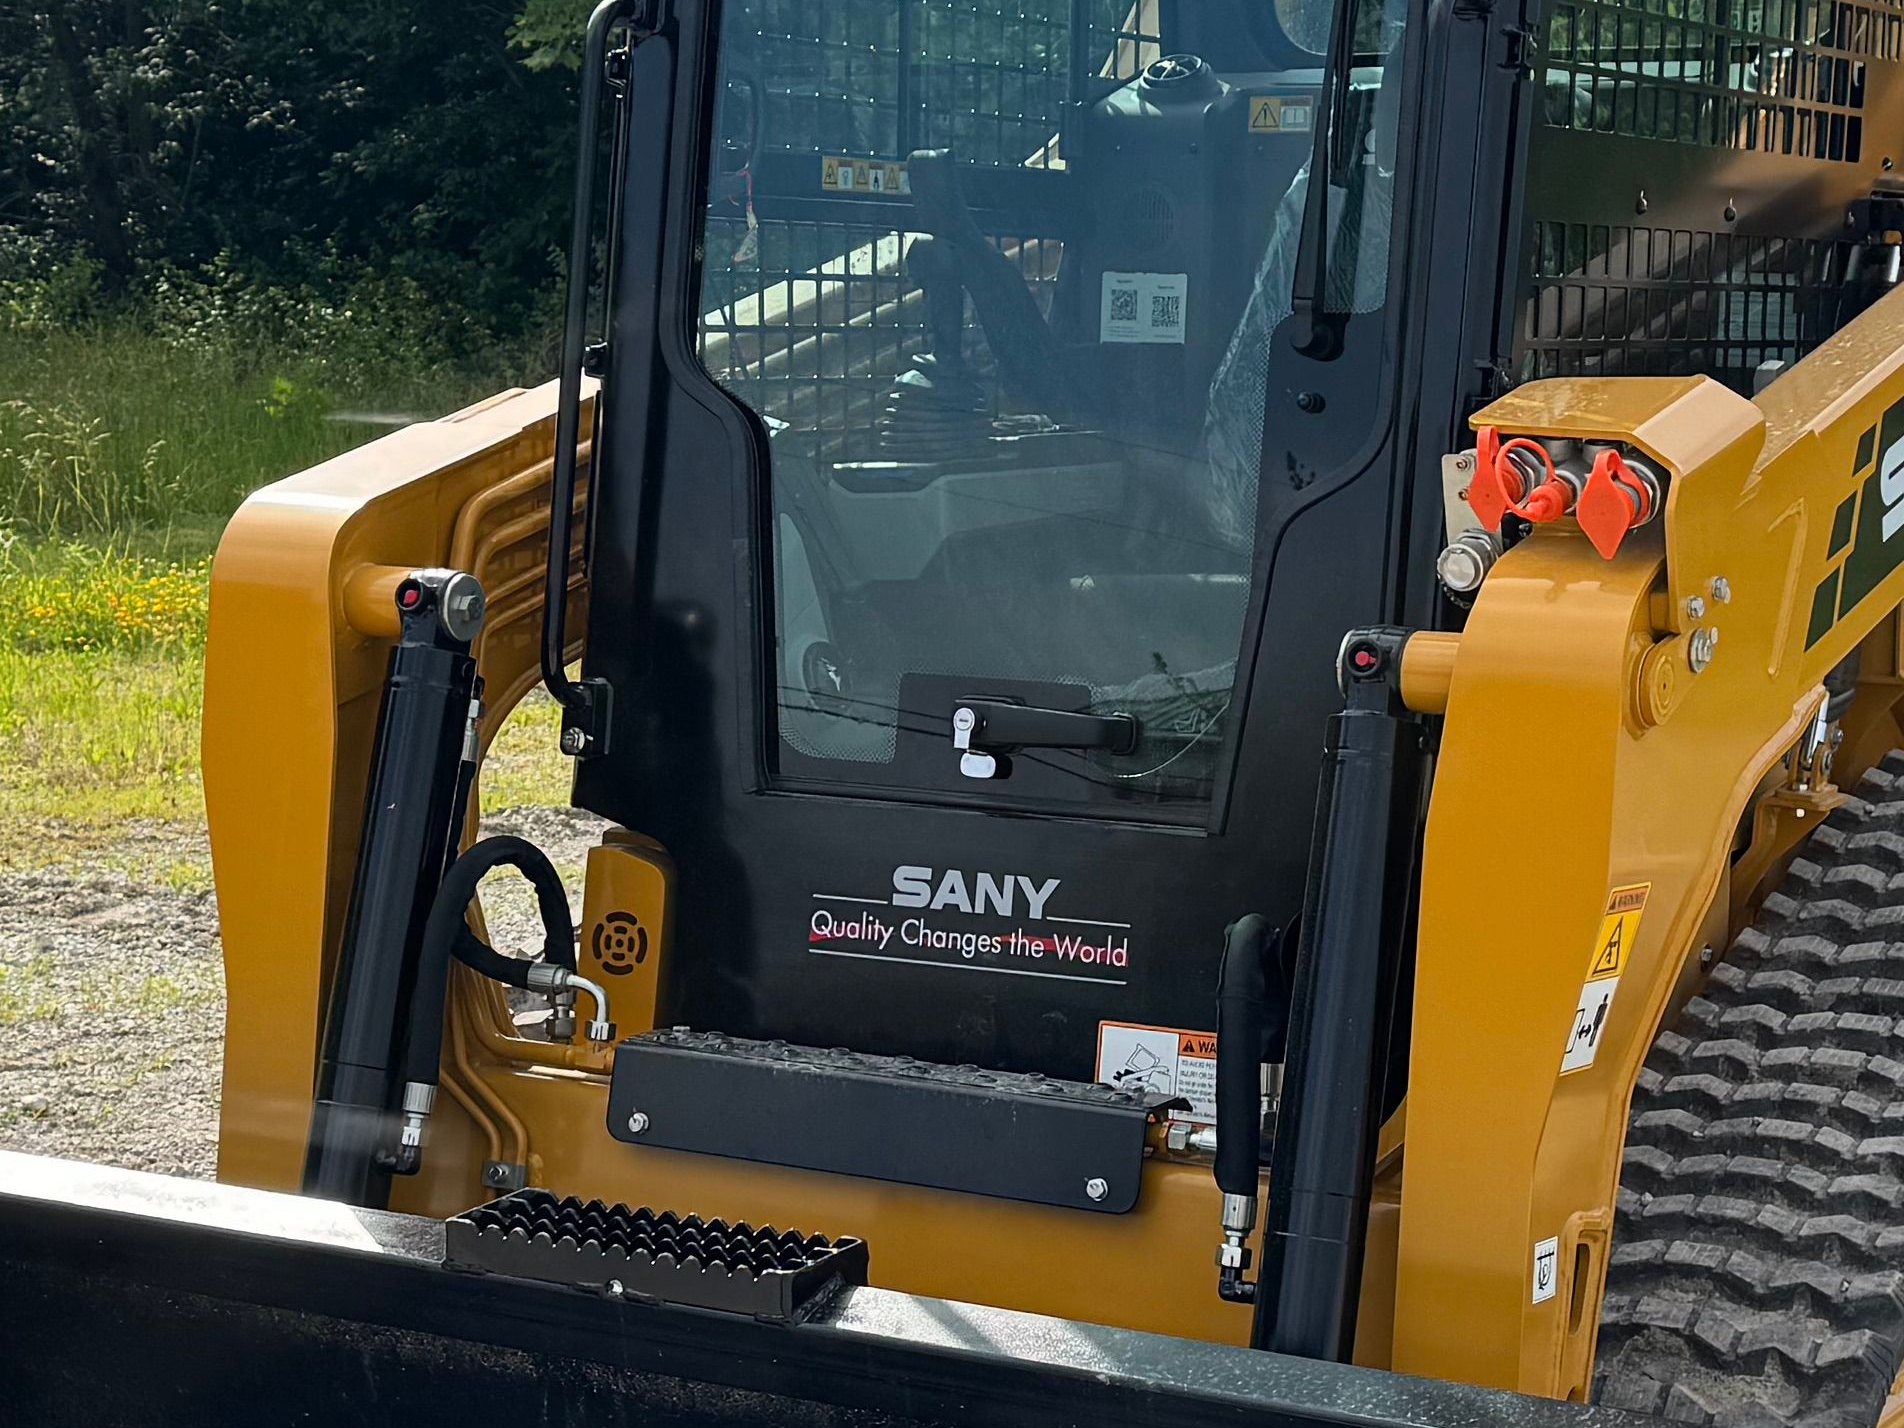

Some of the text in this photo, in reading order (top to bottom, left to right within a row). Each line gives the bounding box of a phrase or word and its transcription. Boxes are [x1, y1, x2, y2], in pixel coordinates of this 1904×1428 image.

[892, 865, 1061, 919] SANY
[811, 909, 1128, 967] Quality Changes the World
